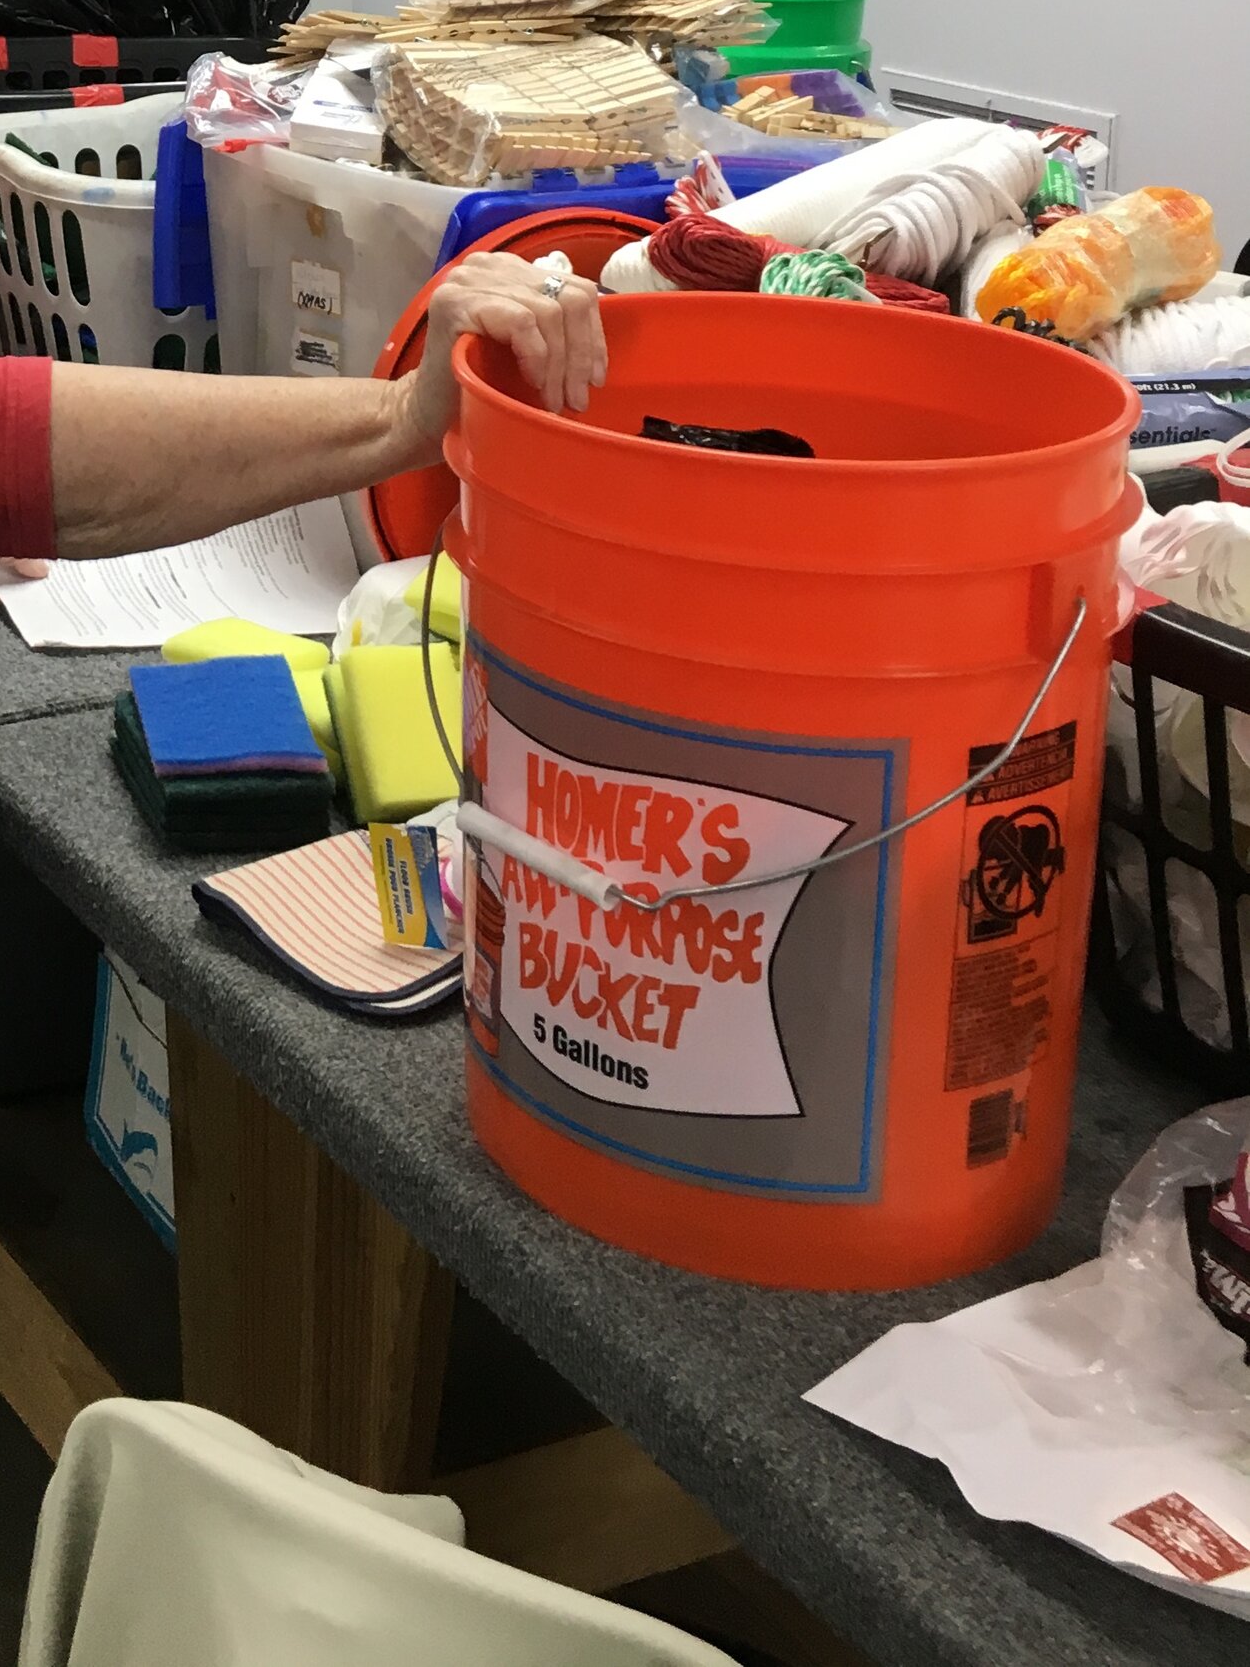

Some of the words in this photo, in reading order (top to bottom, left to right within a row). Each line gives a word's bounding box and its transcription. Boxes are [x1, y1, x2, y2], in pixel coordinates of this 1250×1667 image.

[526, 752, 751, 885] HOMER'S
[518, 922, 702, 1050] BUCKET
[533, 1012, 547, 1044] 5
[552, 1024, 650, 1090] Gallons
